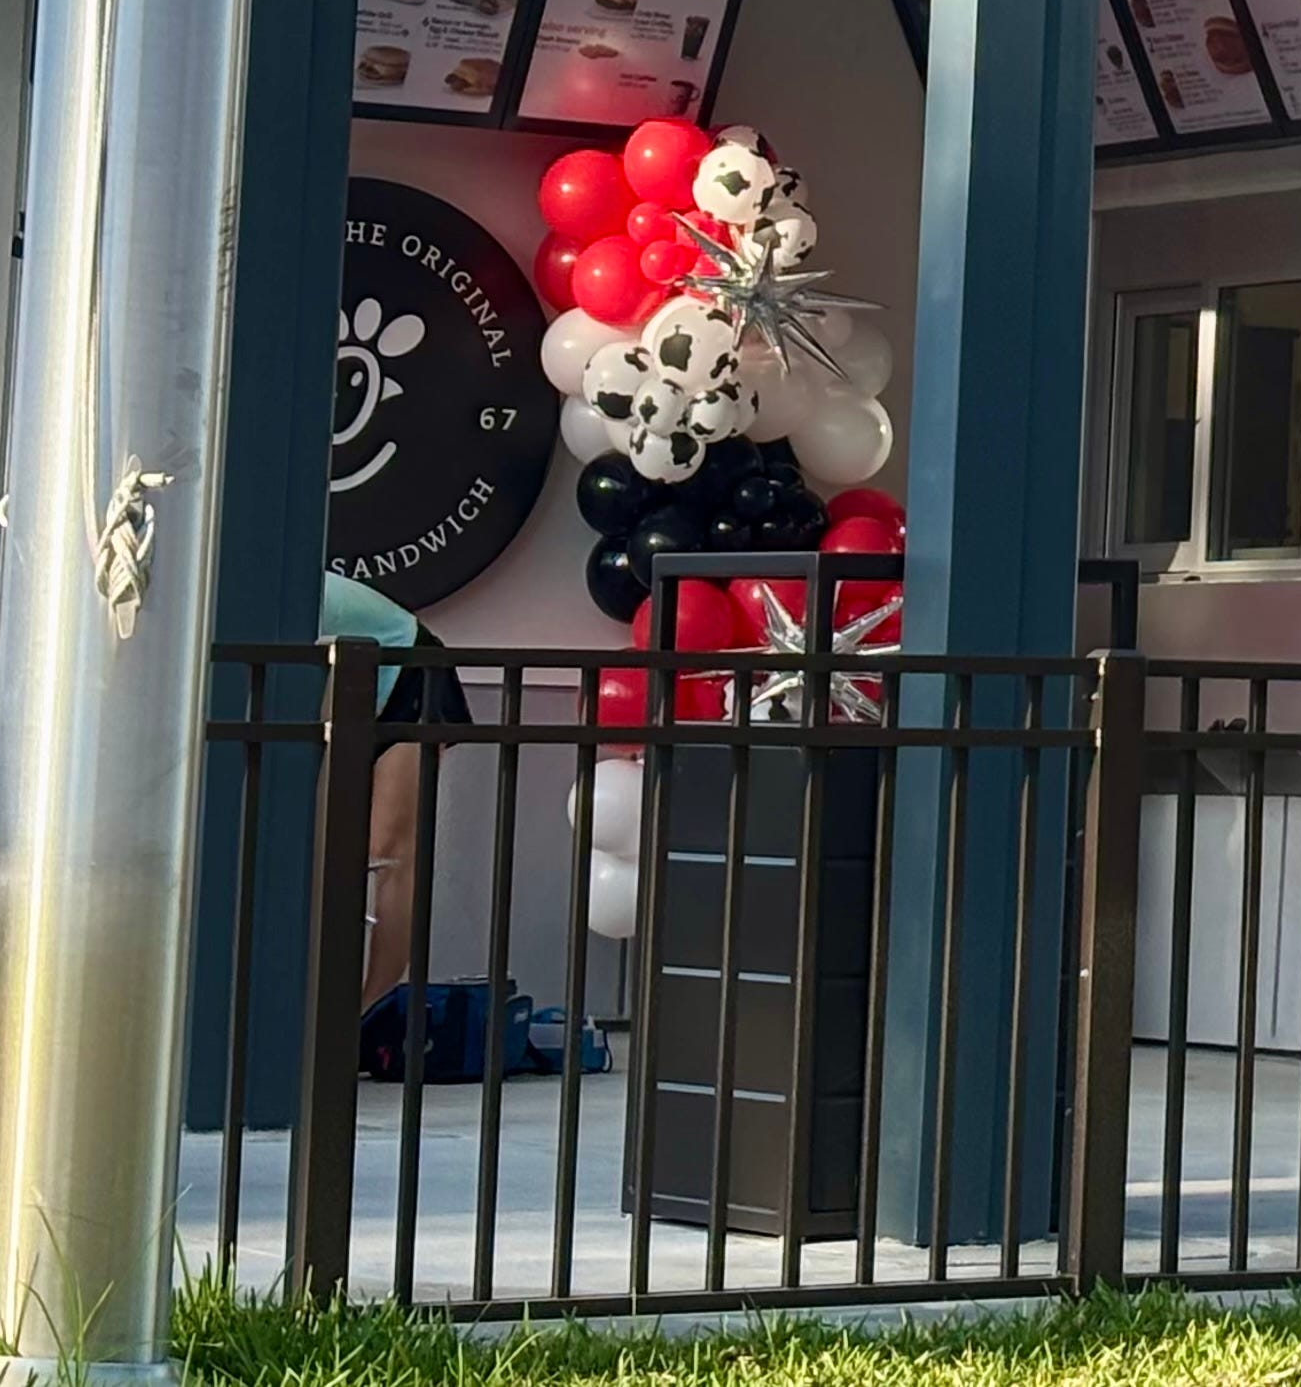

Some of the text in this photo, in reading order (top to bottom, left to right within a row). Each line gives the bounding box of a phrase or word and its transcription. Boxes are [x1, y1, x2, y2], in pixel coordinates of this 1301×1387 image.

[345, 221, 512, 368] HE ORIGINAL
[479, 407, 517, 431] 67
[331, 477, 495, 580] SANDWICH
